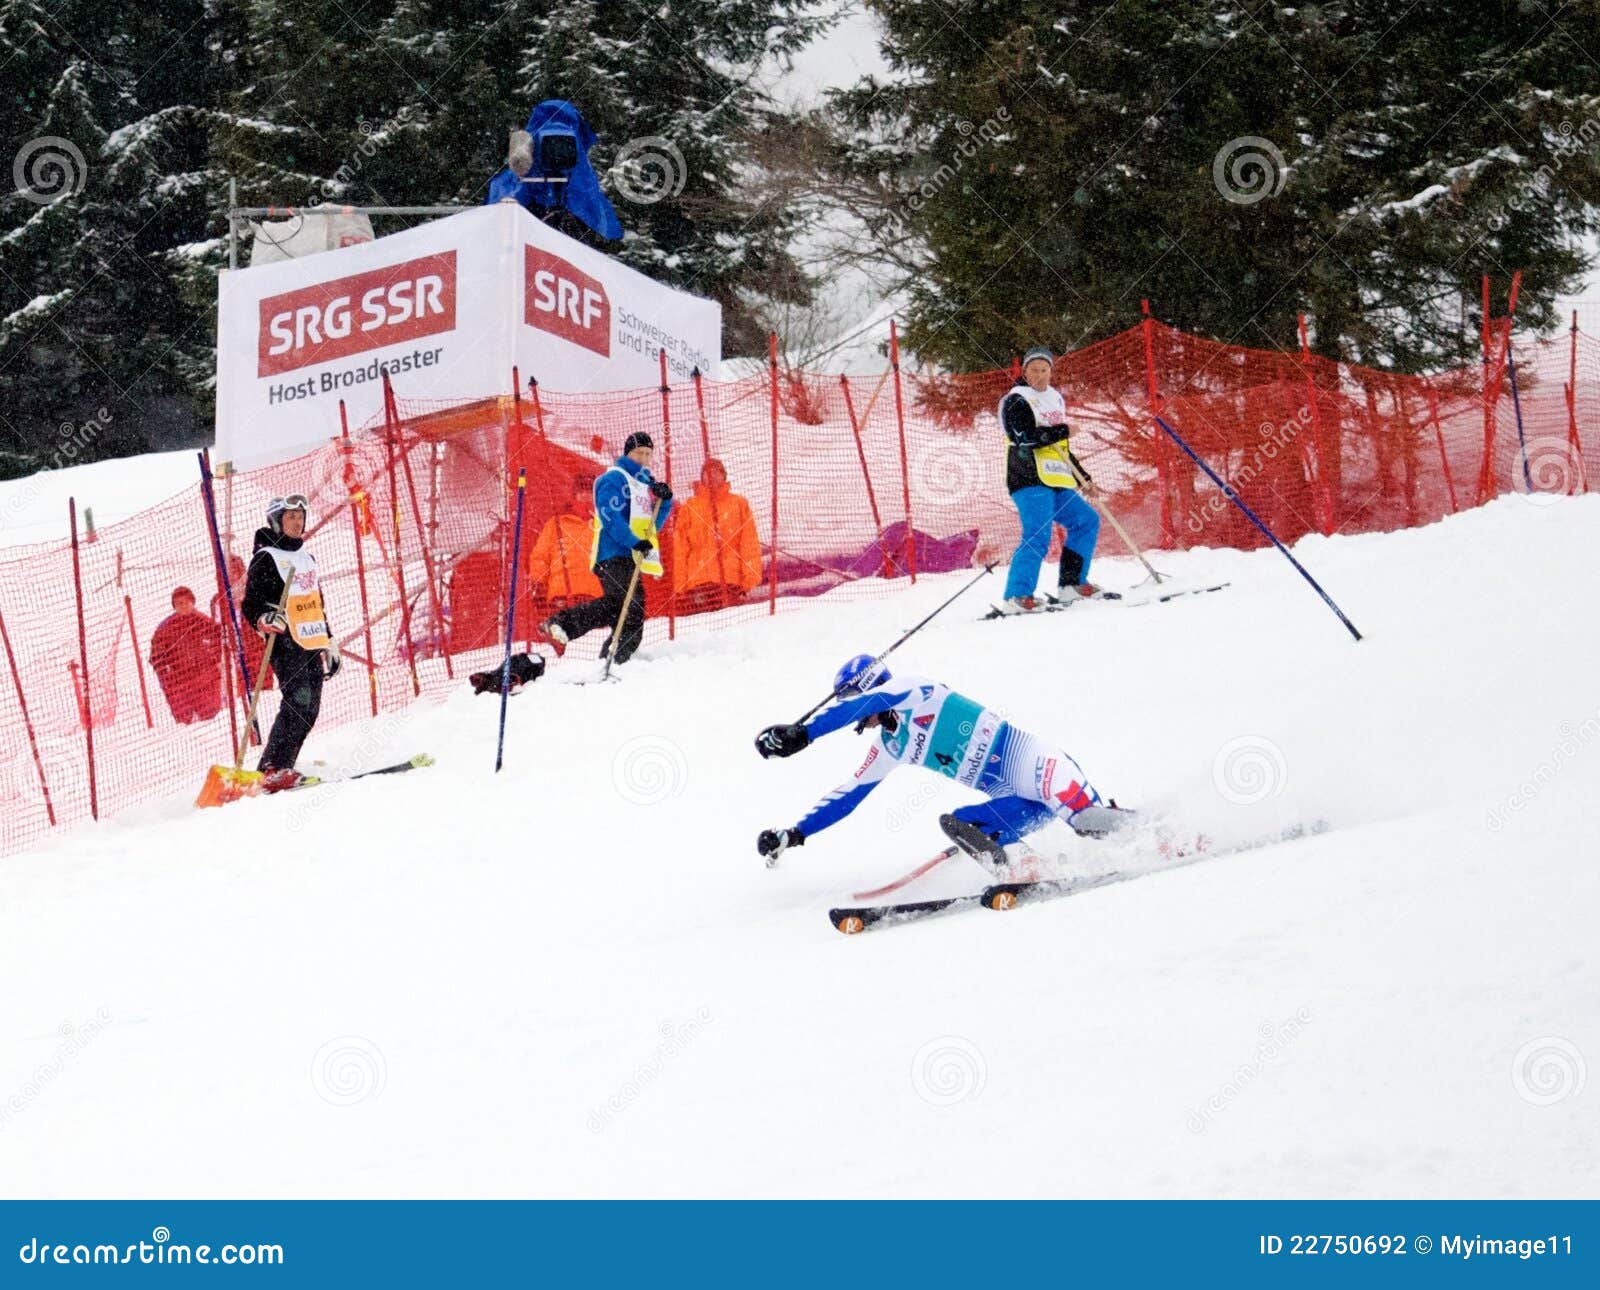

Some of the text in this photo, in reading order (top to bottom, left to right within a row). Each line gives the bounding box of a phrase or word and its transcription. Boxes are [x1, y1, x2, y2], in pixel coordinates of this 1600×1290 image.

[268, 275, 445, 356] SRG SSR
[534, 270, 602, 329] SRF
[618, 306, 710, 373] Schweizer Radio
[618, 330, 642, 351] und
[269, 347, 443, 404] Host Broadcaster
